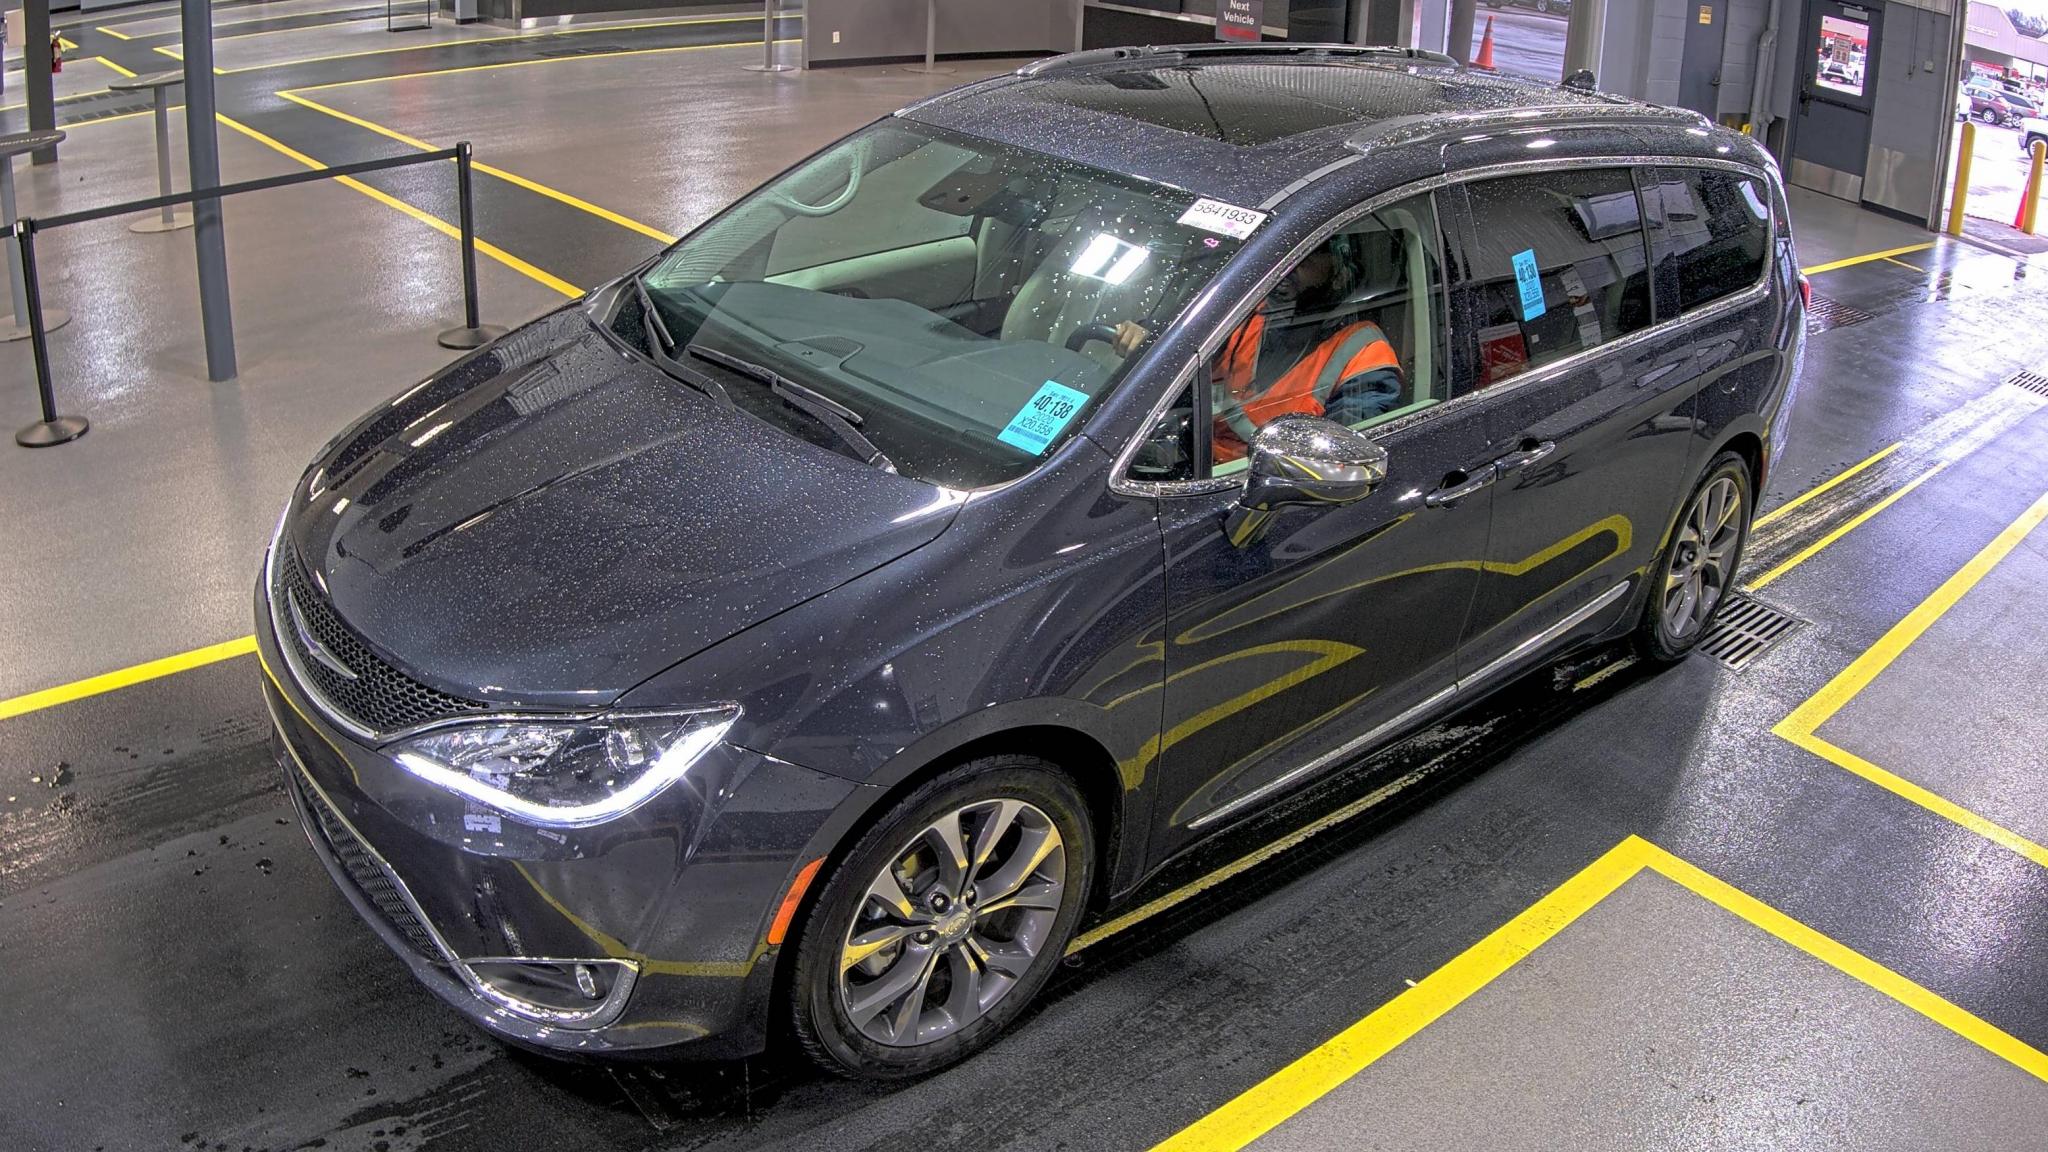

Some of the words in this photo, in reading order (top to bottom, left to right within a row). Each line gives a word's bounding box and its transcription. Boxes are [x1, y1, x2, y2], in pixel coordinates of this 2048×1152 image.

[1230, 0, 1250, 11] Next
[1224, 11, 1255, 25] Vehicle
[1194, 201, 1257, 225] 5841933
[1033, 395, 1074, 419] 40:138
